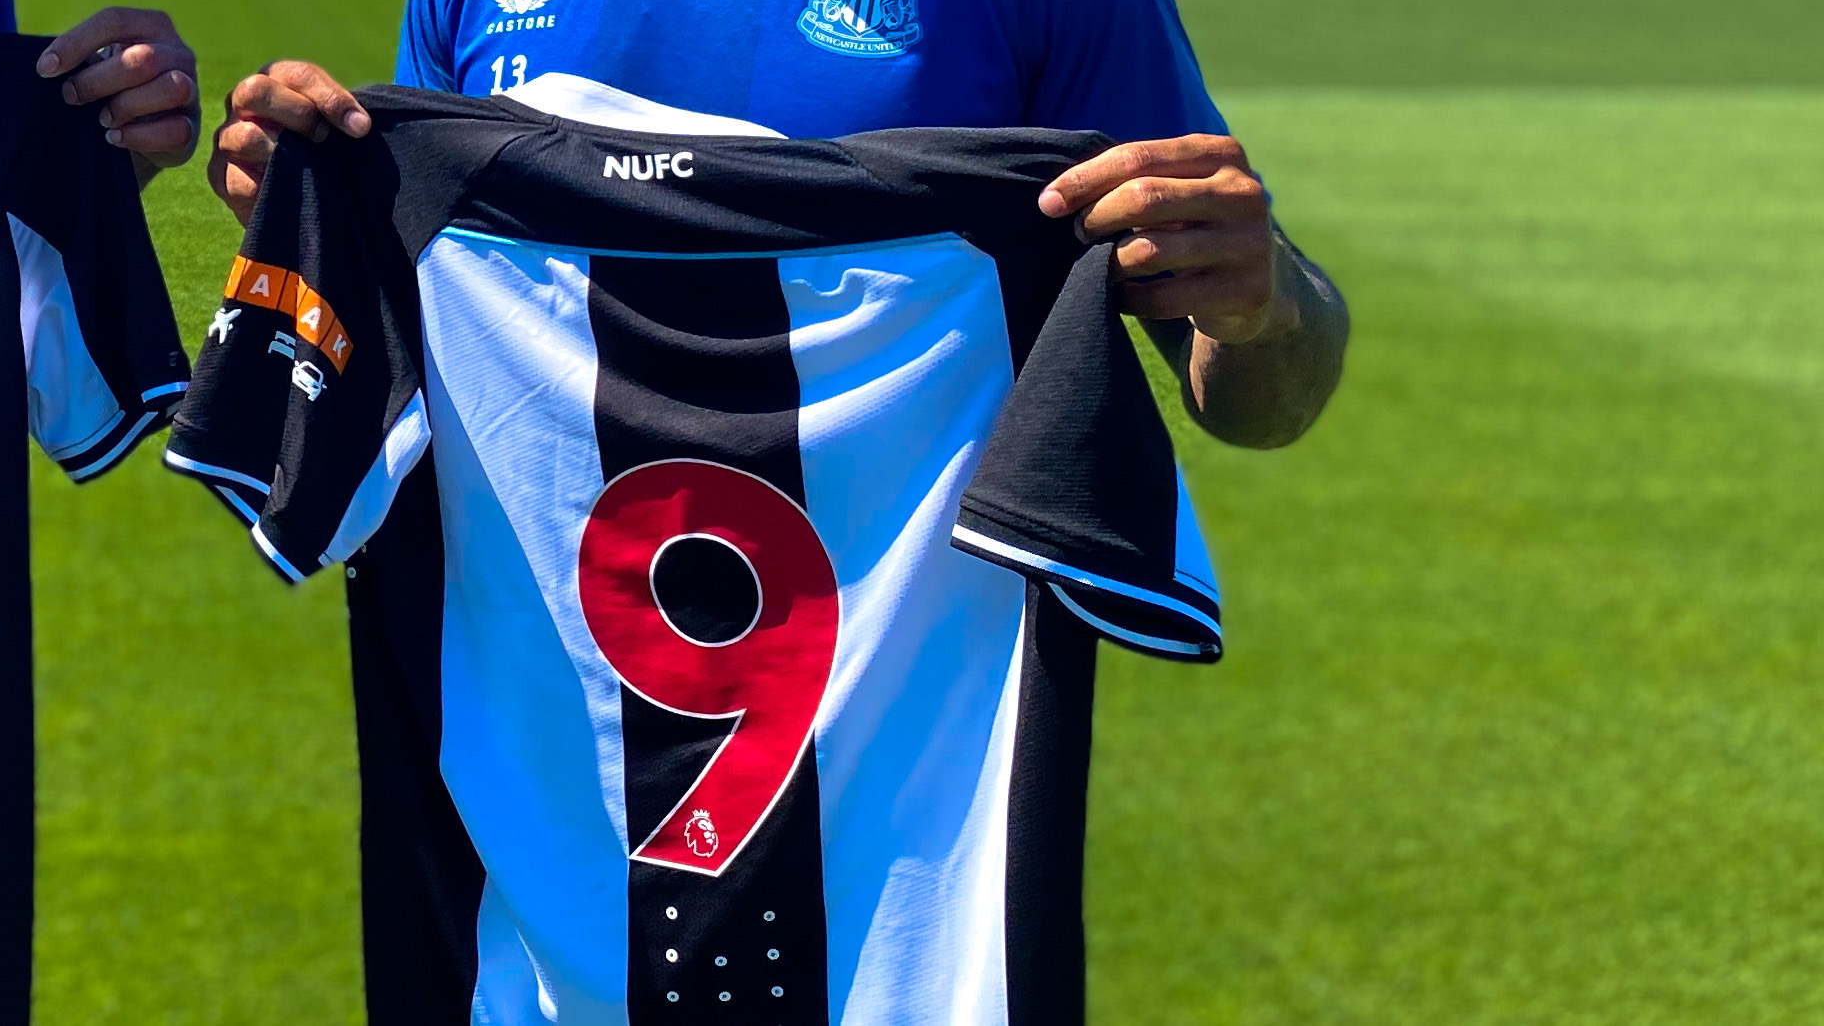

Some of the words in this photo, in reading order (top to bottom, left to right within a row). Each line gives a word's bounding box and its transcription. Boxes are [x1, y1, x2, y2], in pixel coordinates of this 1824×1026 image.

[485, 14, 556, 35] CASTORE
[813, 31, 867, 51] NEWCASTLE
[490, 54, 528, 95] 13
[602, 151, 694, 181] NUFC
[577, 457, 843, 878] 9
